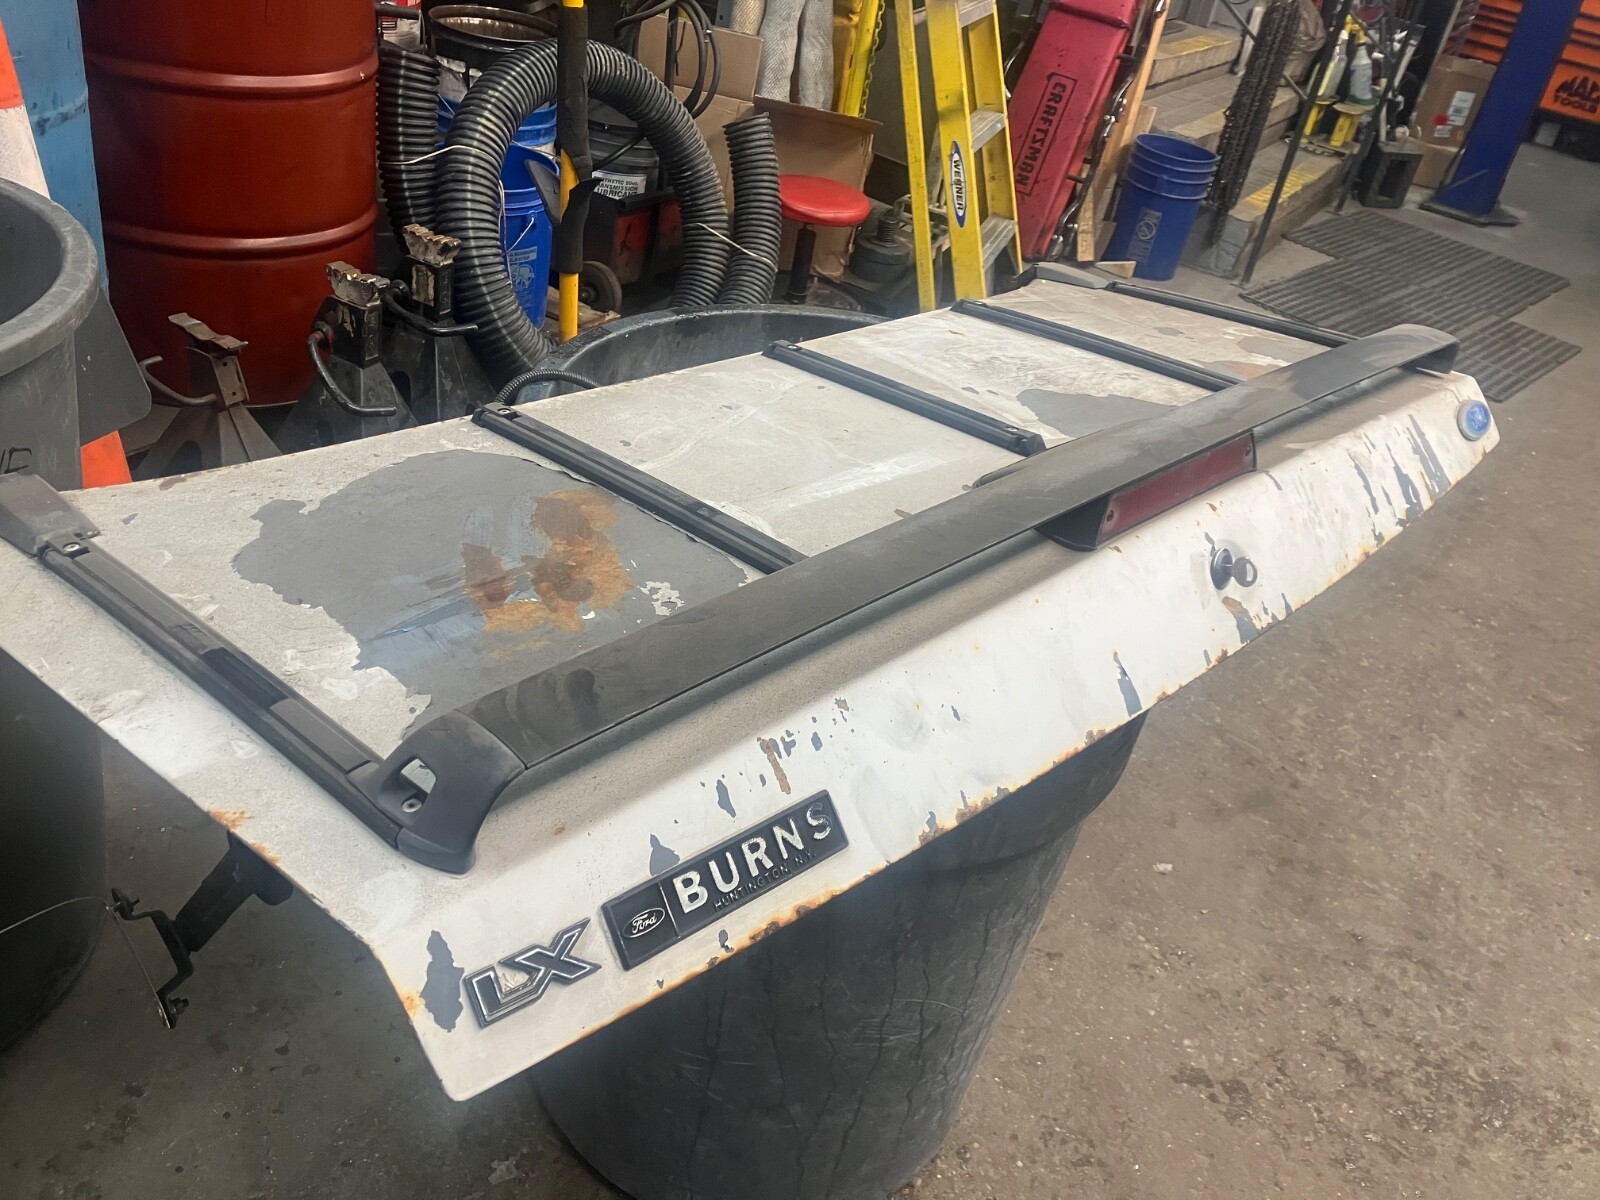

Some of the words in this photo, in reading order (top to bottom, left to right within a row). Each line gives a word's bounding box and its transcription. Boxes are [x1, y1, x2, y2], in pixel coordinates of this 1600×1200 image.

[1016, 81, 1067, 186] CRAFTSMAN
[599, 183, 638, 192] ANSMISSION
[672, 802, 832, 914] BURNS
[464, 917, 602, 1029] LX
[631, 913, 658, 934] Ford
